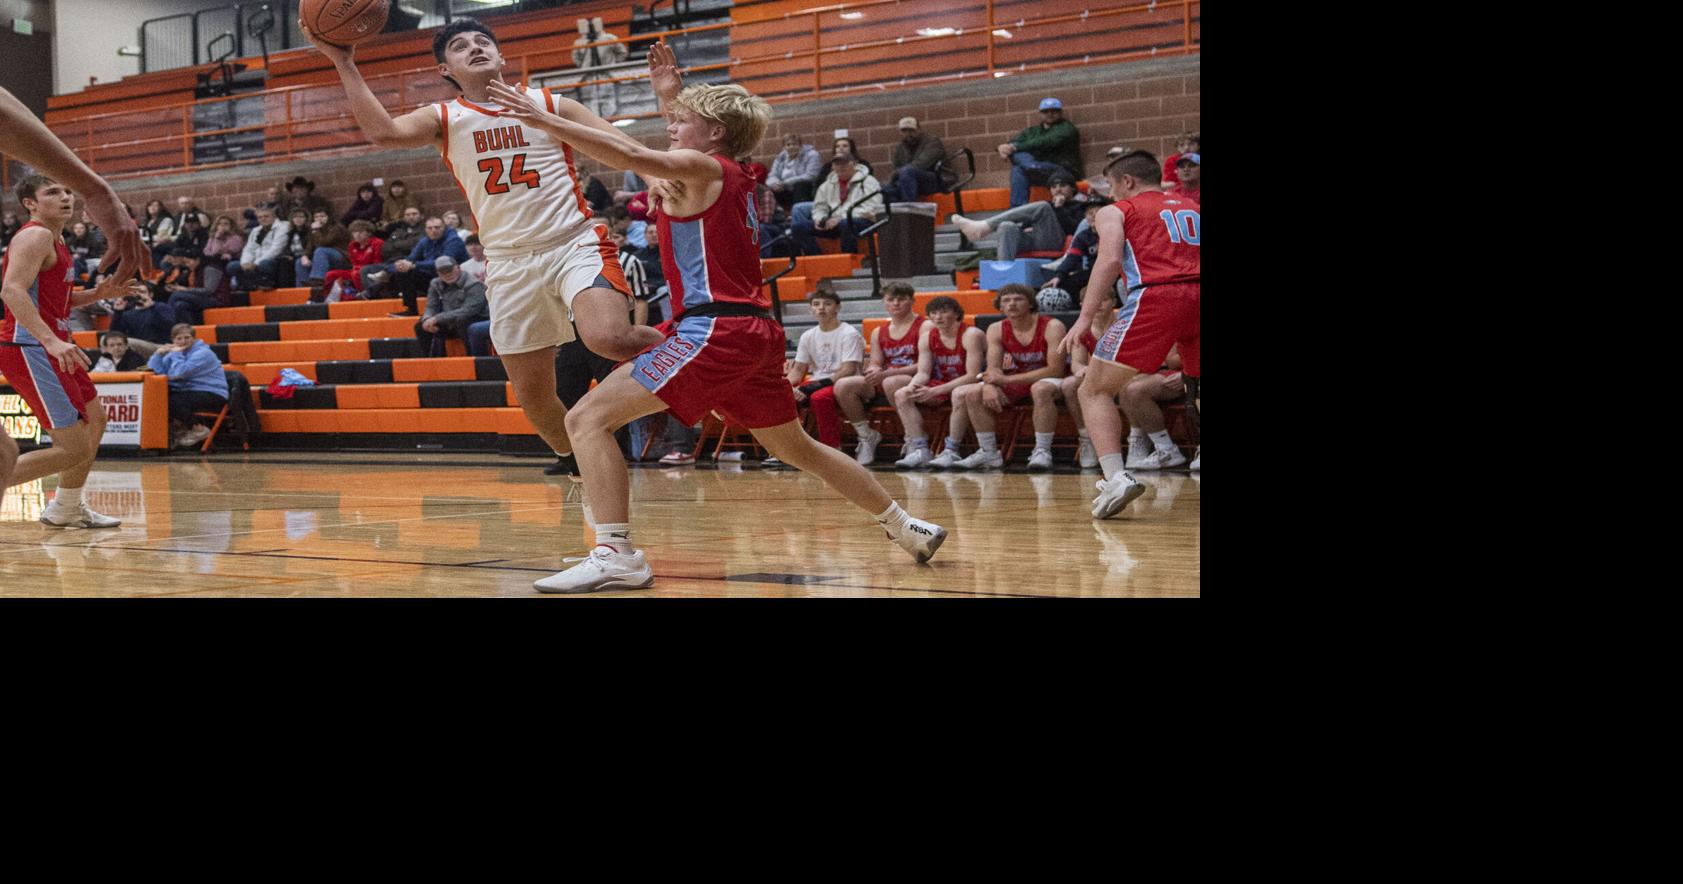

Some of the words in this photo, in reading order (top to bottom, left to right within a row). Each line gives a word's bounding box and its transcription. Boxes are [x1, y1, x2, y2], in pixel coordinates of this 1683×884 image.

[473, 125, 530, 153] BUHL
[477, 153, 540, 195] 24
[1160, 209, 1200, 246] 10
[641, 337, 695, 382] EAGLES
[104, 404, 139, 422] ARD
